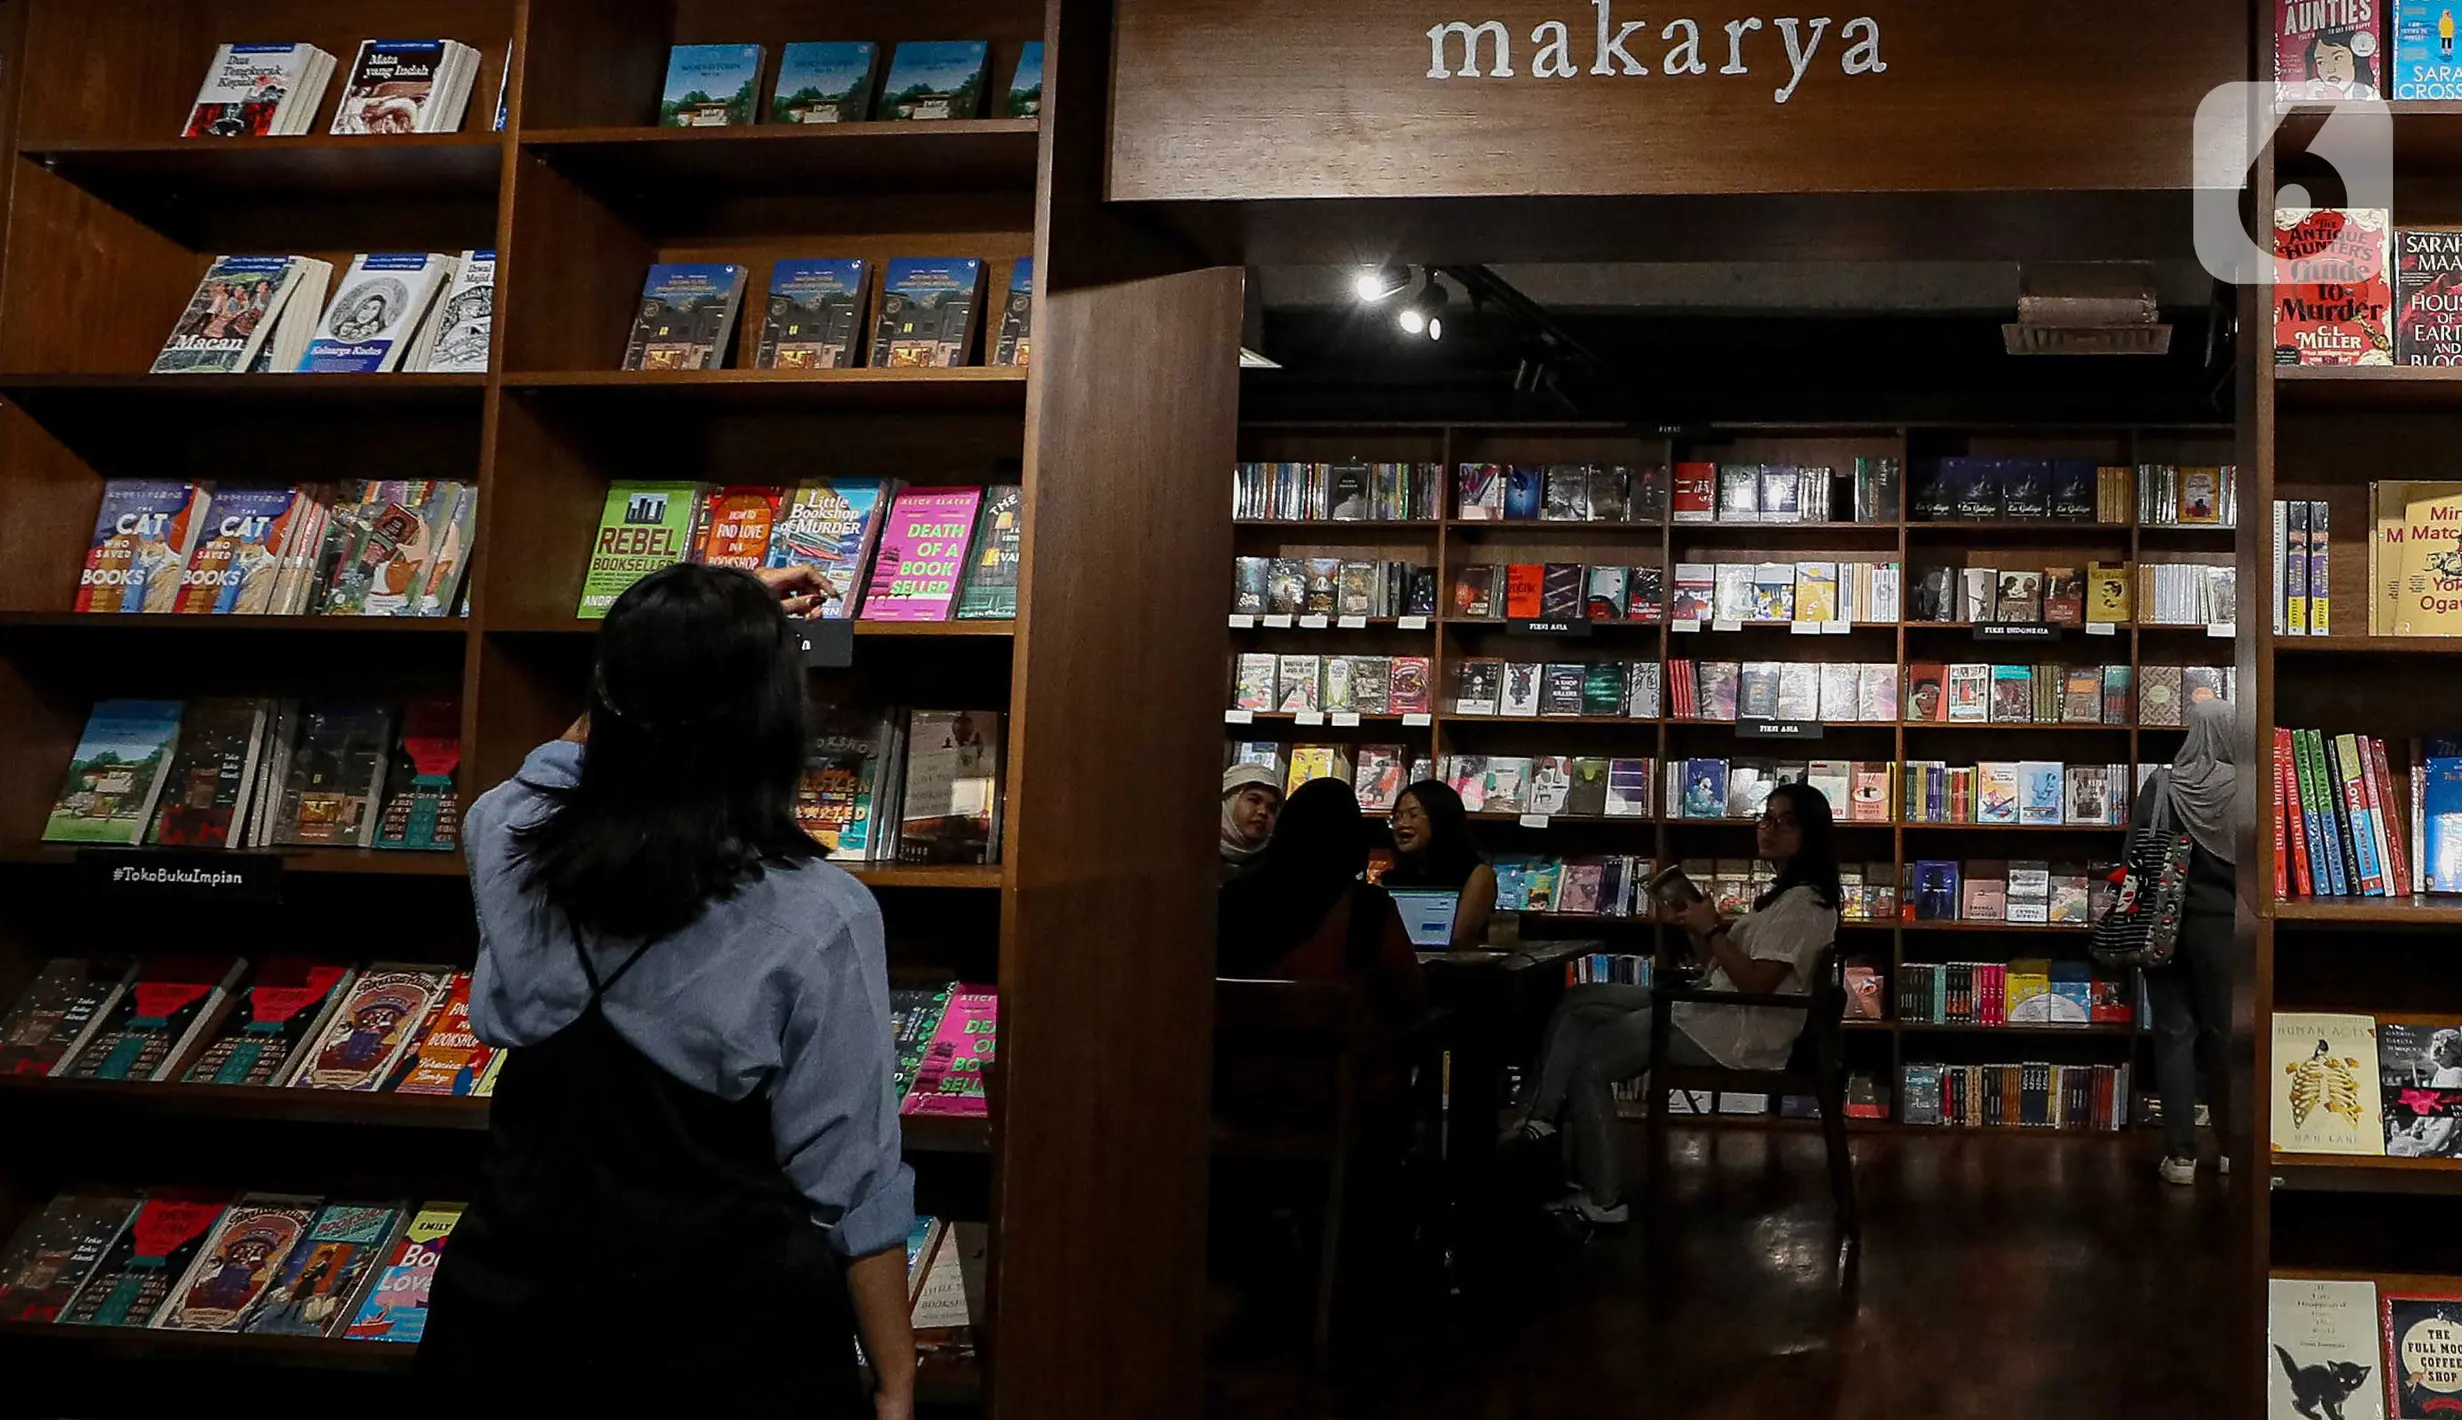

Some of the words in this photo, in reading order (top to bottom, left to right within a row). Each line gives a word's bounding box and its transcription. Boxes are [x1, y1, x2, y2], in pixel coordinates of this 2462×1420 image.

[2284, 0, 2372, 36] AUNTIES
[1425, 0, 1888, 103] makarya
[363, 67, 394, 79] yang
[394, 65, 429, 76] Indah
[2289, 226, 2367, 245] ANTIQUE
[2277, 240, 2374, 261] HUNTER'S
[2291, 260, 2371, 284] Guide
[2318, 283, 2345, 301] to
[2280, 298, 2384, 322] Murder
[2437, 312, 2456, 324] OF
[172, 334, 244, 350] Macan
[2295, 332, 2362, 349] MILLER
[2433, 343, 2462, 354] AND
[808, 492, 849, 508] Little
[989, 493, 1019, 517] THE
[791, 503, 860, 522] Bookshop
[116, 513, 169, 535] CAT
[220, 516, 270, 538] CAT
[739, 524, 764, 539] LOVE
[780, 520, 796, 533] of
[795, 519, 861, 535] MURDER
[907, 523, 966, 538] DEATH
[103, 539, 130, 549] WHO
[206, 541, 231, 549] WHO
[598, 527, 677, 556] REBEL
[917, 542, 942, 557] OF
[944, 542, 959, 557] A
[95, 549, 132, 559] SAVED
[197, 550, 232, 560] SAVED
[80, 569, 147, 585] BOOKS
[899, 561, 956, 577] BOOK
[180, 569, 242, 586] BOOKS
[890, 580, 950, 595] SELLER
[583, 594, 617, 607] ANDR
[112, 866, 243, 887] #TokoBukuImpian
[2278, 1025, 2325, 1036] HUMAN
[418, 1221, 451, 1231] EMILY
[2427, 1329, 2450, 1340] THE
[2408, 1343, 2436, 1353] FULL
[2420, 1357, 2462, 1367] COFFEE
[2428, 1371, 2458, 1382] SHOP
